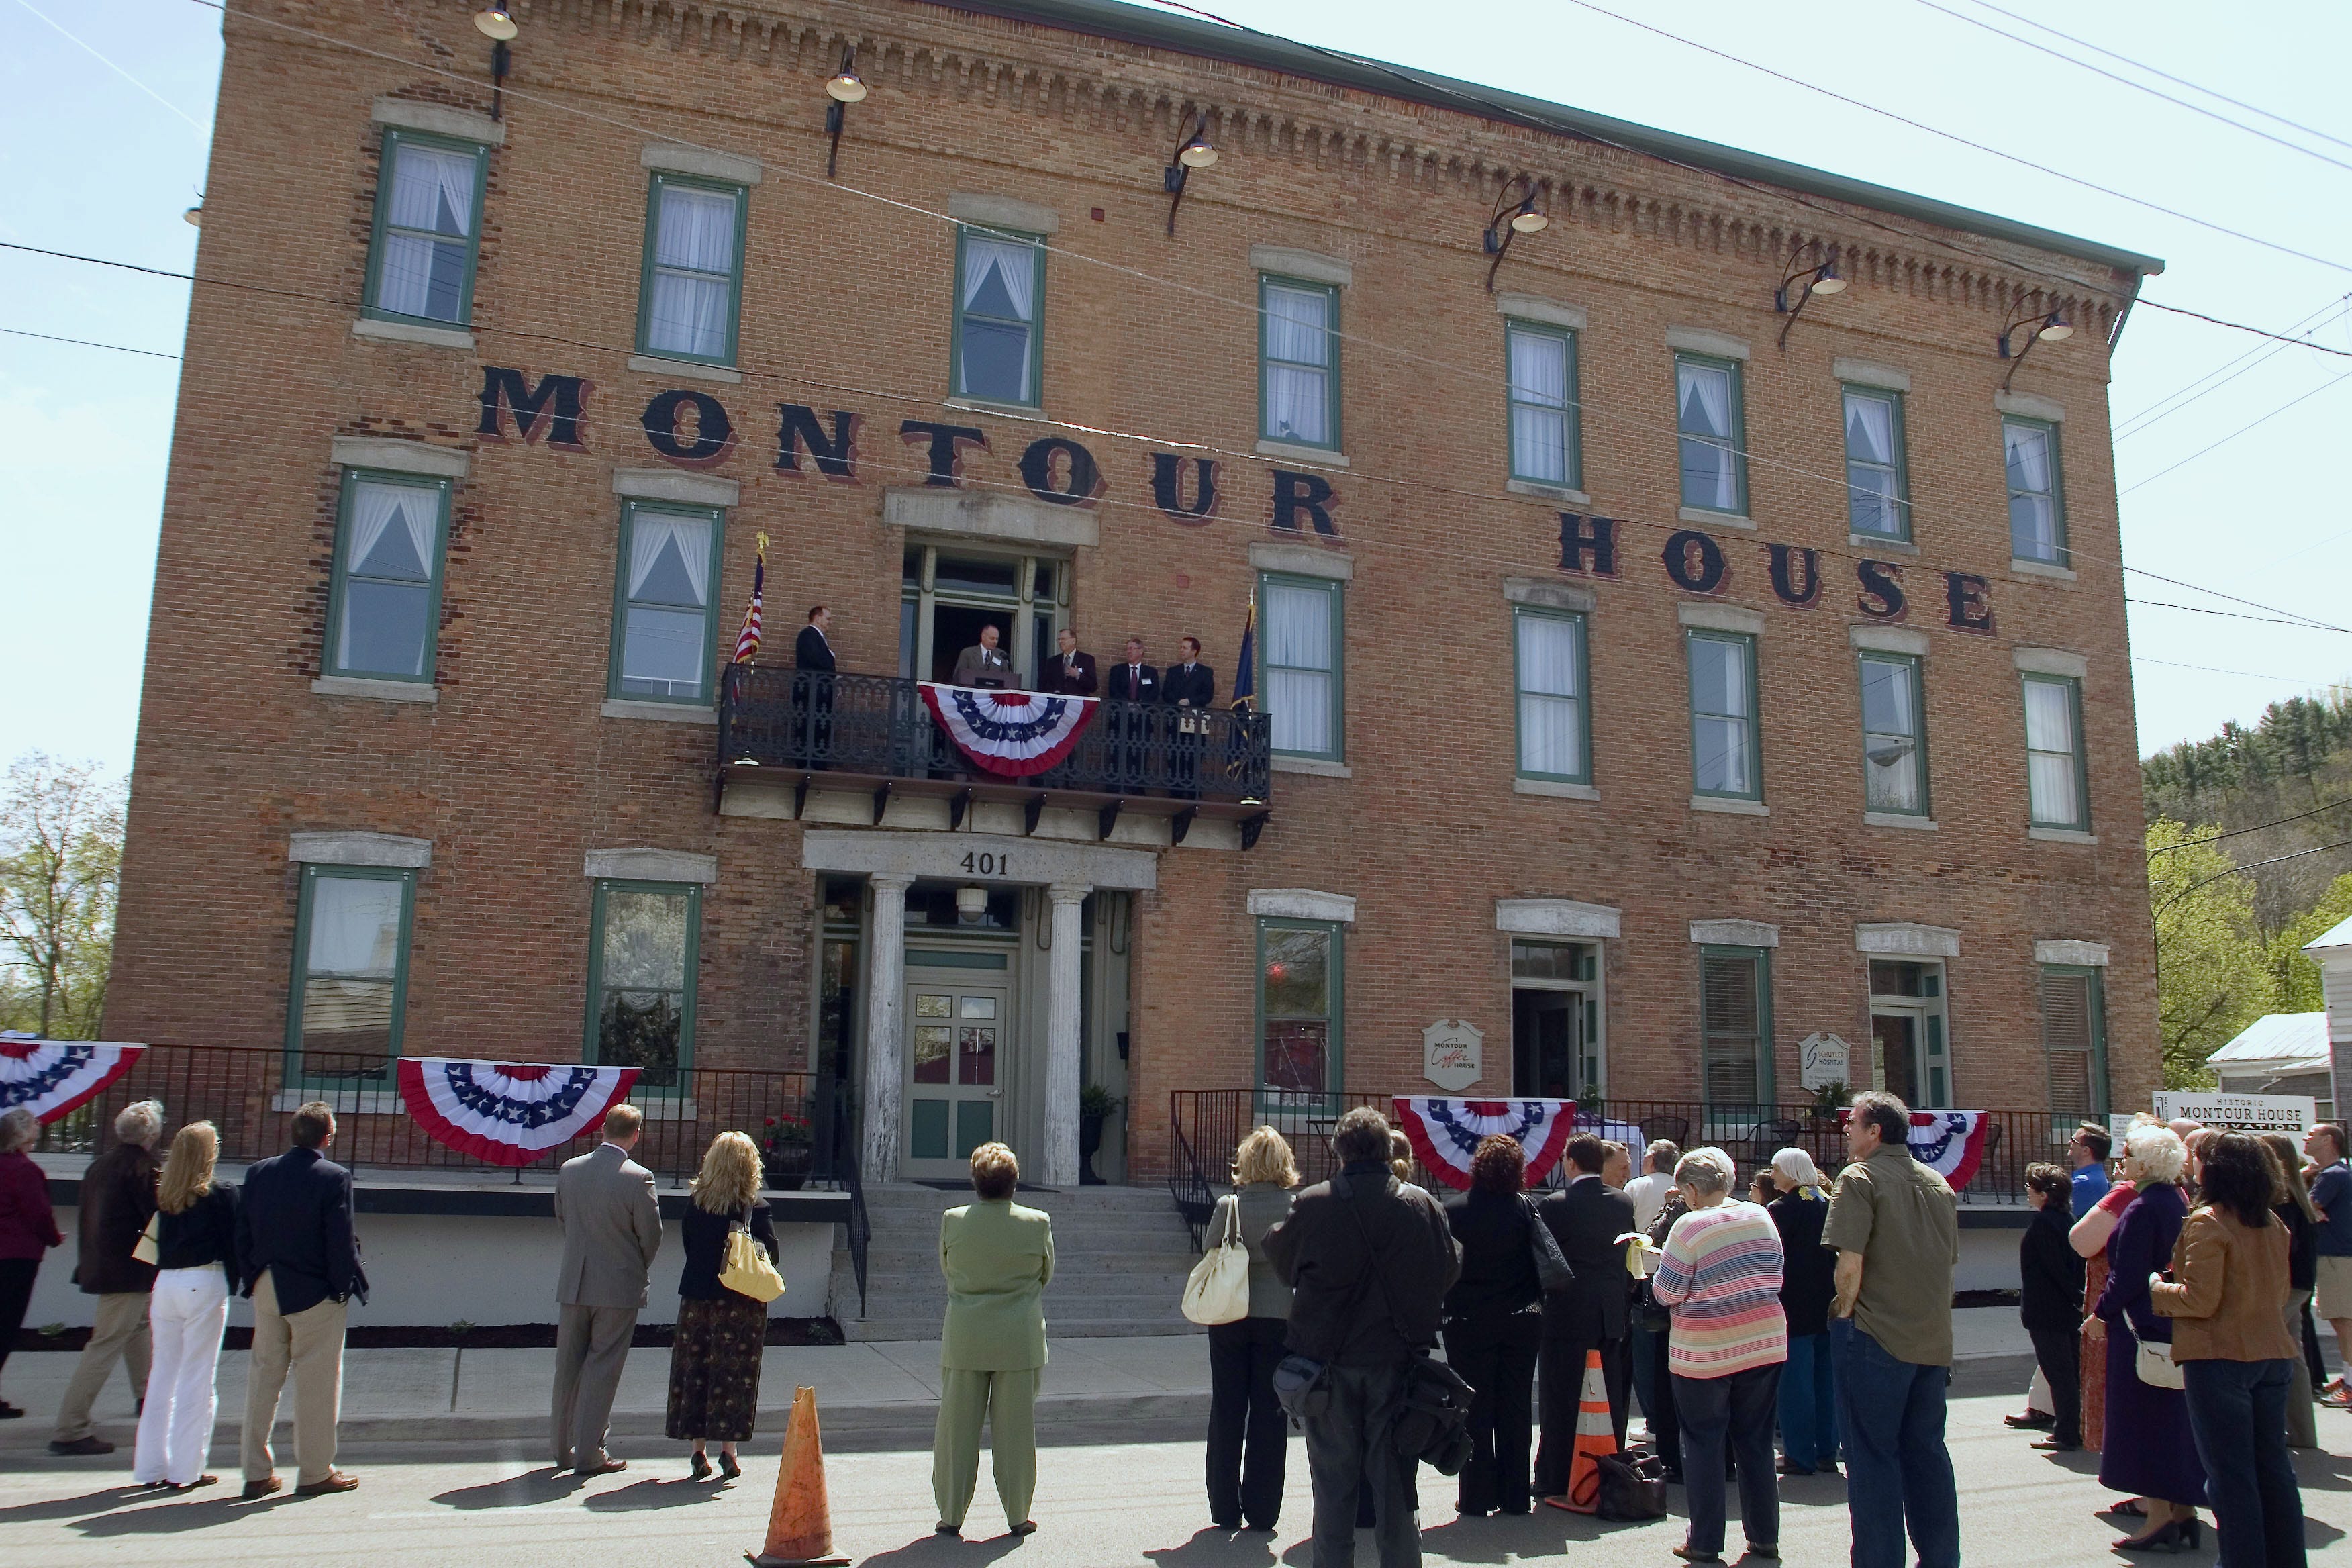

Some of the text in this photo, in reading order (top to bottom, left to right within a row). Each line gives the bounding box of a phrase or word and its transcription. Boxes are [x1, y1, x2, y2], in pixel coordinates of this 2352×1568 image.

[474, 365, 1996, 636] MONTOUR HOUSE
[960, 852, 1007, 875] 401
[1431, 1037, 1472, 1069] Coffee
[2216, 1099, 2263, 1107] HISTORIC
[2179, 1106, 2301, 1122] MONTOUR HOUSE
[2200, 1122, 2298, 1131] NOVATION
